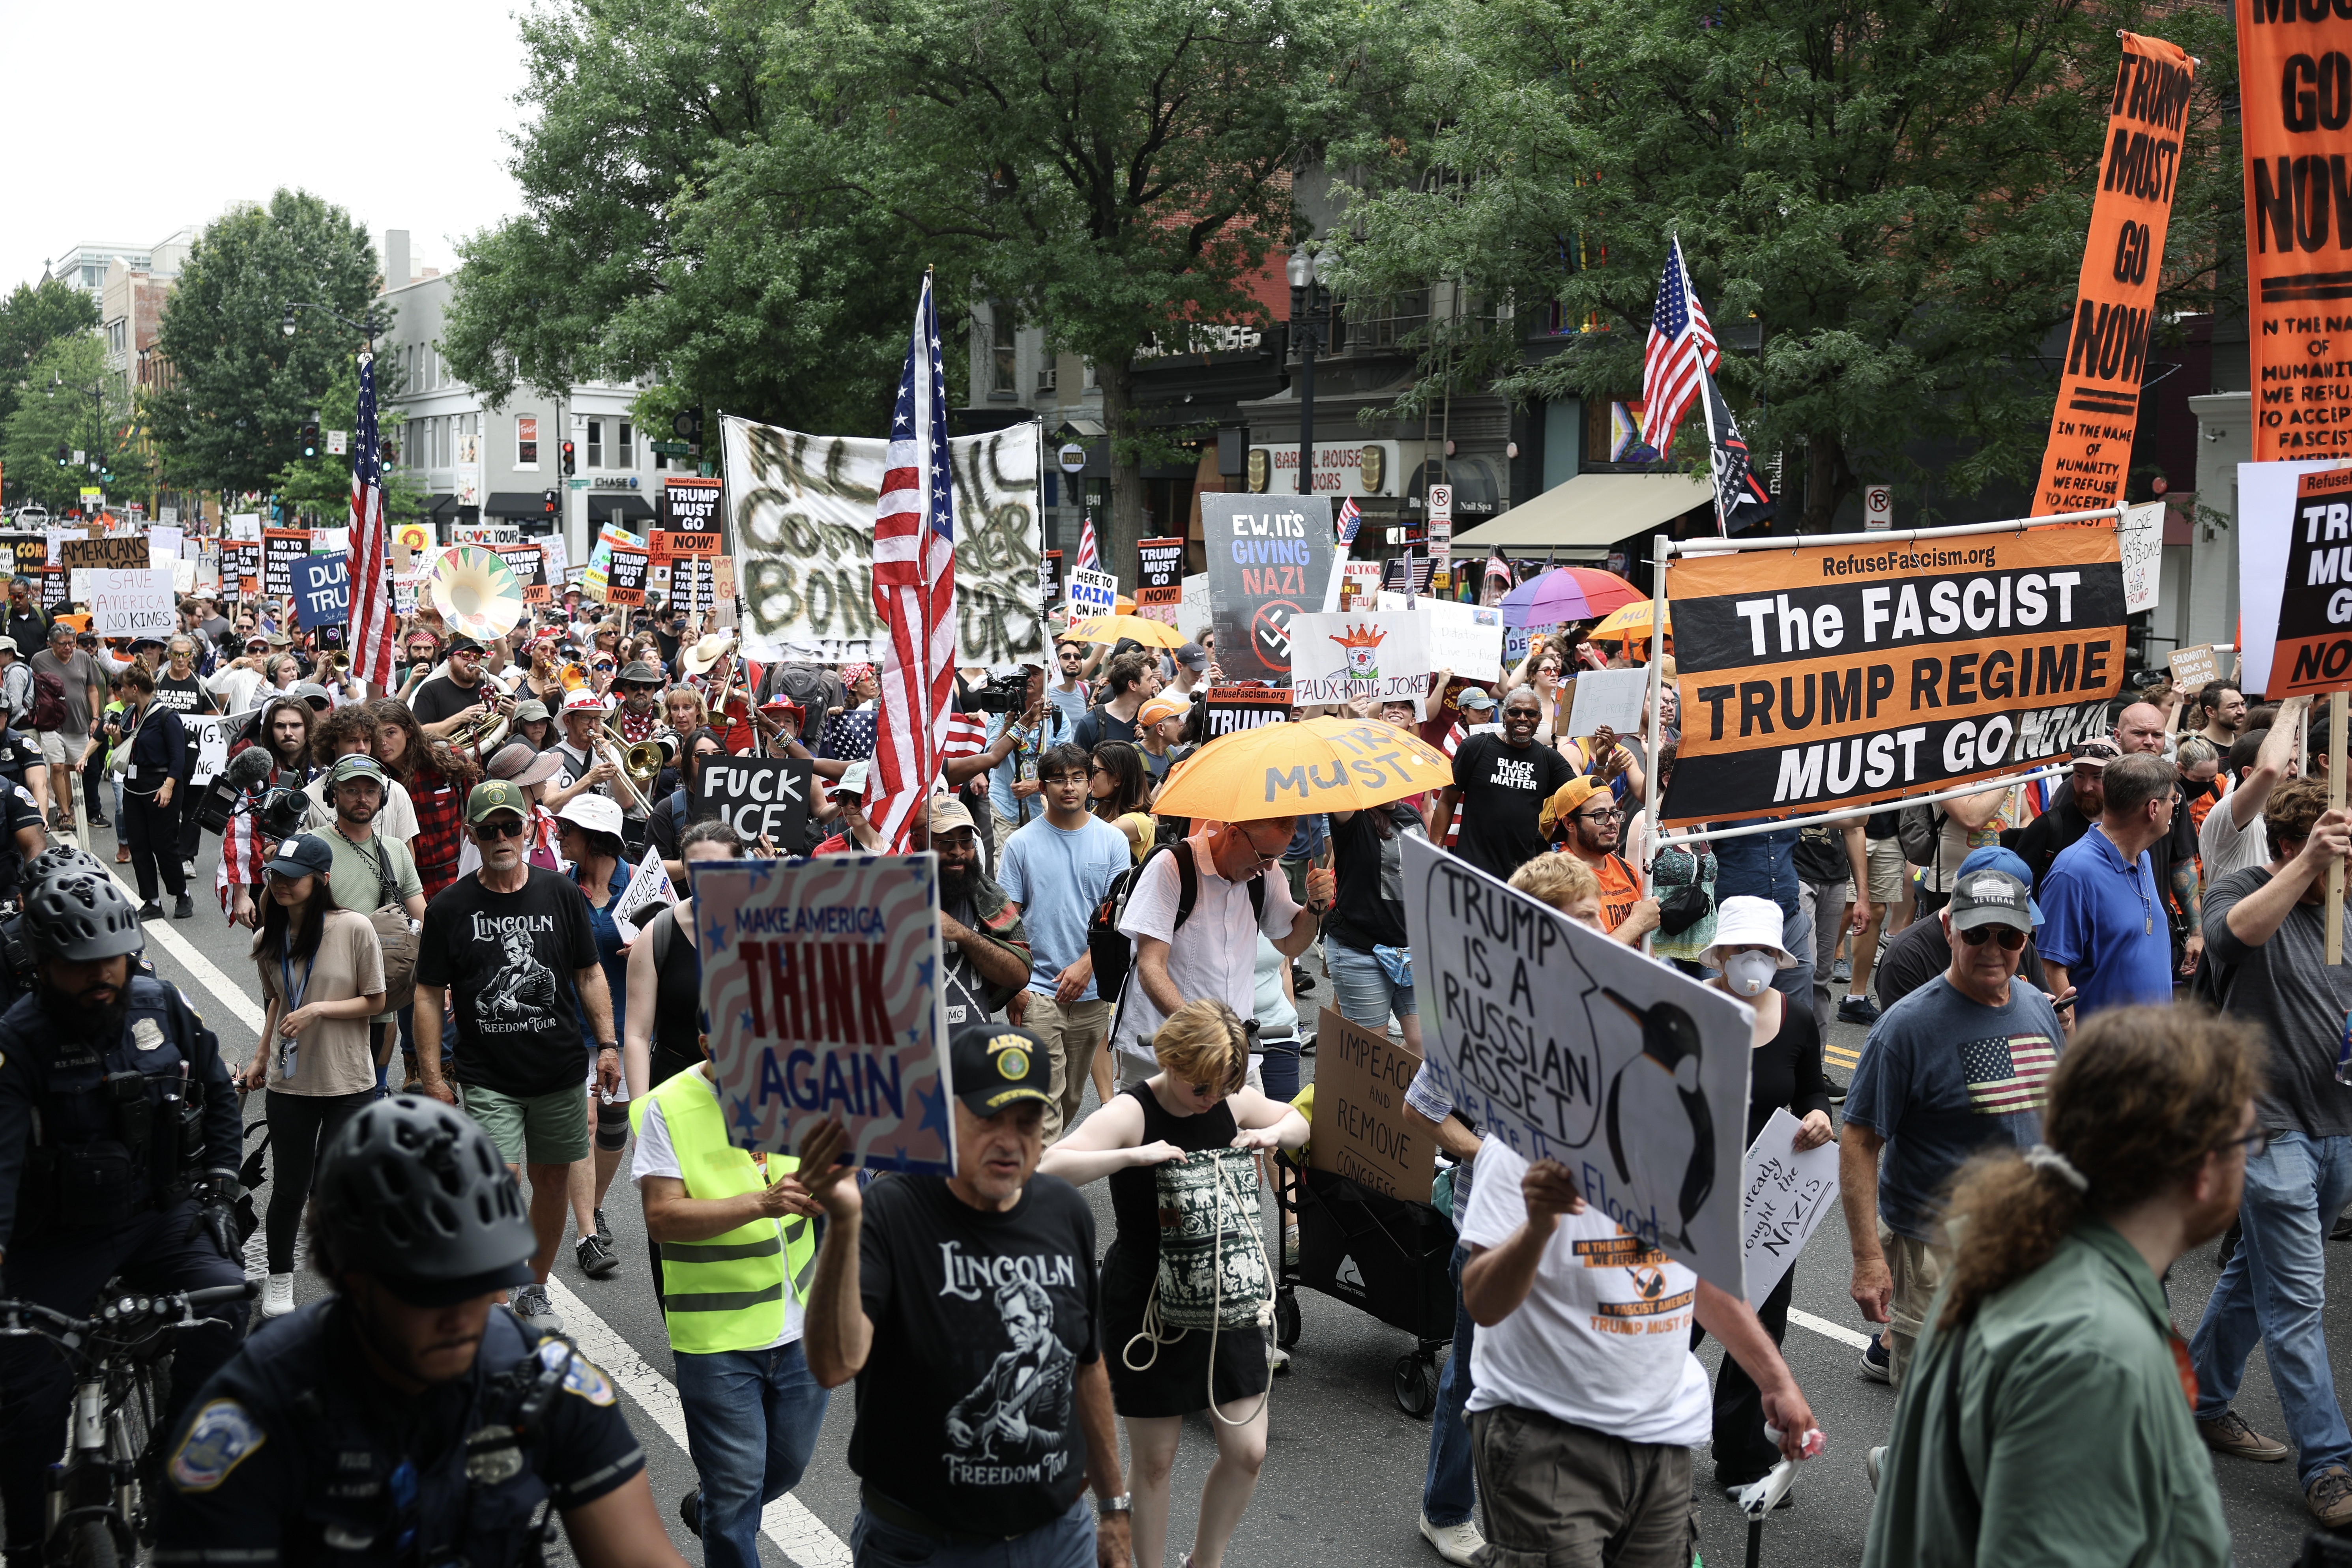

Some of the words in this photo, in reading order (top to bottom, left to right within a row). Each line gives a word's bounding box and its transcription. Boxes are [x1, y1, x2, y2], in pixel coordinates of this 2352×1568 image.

[2112, 52, 2192, 132] TRUMP
[2281, 52, 2352, 133] GO
[2103, 129, 2178, 204] MUST
[2113, 219, 2150, 285] GO
[2285, 316, 2321, 334] THE
[2068, 299, 2152, 384] NOW
[2308, 340, 2330, 356] OF
[2262, 387, 2294, 404] WE
[2260, 411, 2283, 427] TO
[2057, 421, 2075, 435] IN
[2079, 424, 2100, 438] THE
[2102, 427, 2132, 442] NAME
[2086, 443, 2101, 456] OF
[1275, 450, 1318, 469] BARL
[1323, 449, 1361, 468] HOUSE
[2056, 458, 2119, 479] HUMANITY,
[595, 478, 628, 486] CHASE
[1294, 473, 1341, 490] LUORS
[2054, 475, 2071, 489] WE
[2073, 477, 2118, 494] REFUSE
[668, 488, 719, 501] TRUMP
[1086, 495, 1101, 505] 1341
[2045, 492, 2061, 505] TO
[2063, 494, 2108, 509] ACCEPT
[673, 503, 714, 516] MUST
[1460, 501, 1476, 510] Nail
[1477, 502, 1492, 513] Spa
[683, 517, 704, 530] GO
[1232, 514, 1274, 539] EW,
[1276, 509, 1305, 537] IT'S
[2126, 511, 2153, 543] MORE
[494, 530, 518, 543] YOUR
[615, 530, 629, 539] STOP
[673, 536, 714, 549] NOW!
[61, 537, 149, 562] AMERICANS
[273, 540, 287, 550] NO
[290, 541, 302, 550] TO
[1232, 539, 1310, 566] GIVING
[2136, 538, 2161, 564] B-DAYS
[500, 551, 540, 563] TRUMP
[613, 553, 648, 566] TRUMP
[1140, 548, 1181, 561] TRUMP
[1823, 546, 1995, 577] RefuseFascism.org
[165, 561, 181, 572] NO
[224, 563, 238, 571] TRUMP'S
[614, 565, 643, 577] MUST
[698, 563, 711, 571] TO
[1144, 561, 1177, 573] MUST
[2129, 567, 2145, 583] USA
[107, 570, 154, 590] SAVE
[224, 573, 238, 581] FASCIST
[620, 576, 635, 587] GO
[1077, 571, 1099, 586] HERE
[1102, 576, 1112, 588] TO
[1152, 574, 1169, 585] GO
[1242, 566, 1305, 595] NAZI
[223, 582, 239, 591] MILITARY
[612, 589, 640, 601] NOW!
[1072, 584, 1114, 606] RAIN
[1144, 588, 1177, 602] NOW!
[2129, 582, 2143, 593] OVER
[97, 594, 166, 612] AMERICA
[2127, 588, 2149, 606] TRUMP
[1076, 604, 1089, 616] ON
[1736, 594, 1843, 656] The
[1862, 572, 2080, 642] FASCIST
[107, 612, 126, 630] NO
[130, 611, 171, 628] KINGS
[1442, 627, 1480, 640] Dictator
[1441, 644, 1460, 656] Live
[1467, 649, 1476, 657] In
[2172, 649, 2207, 665] SOLIDARITY
[1455, 664, 1473, 675] Lover
[2178, 662, 2200, 675] KNOWS
[2202, 660, 2212, 670] NO
[1295, 678, 1380, 702] FAUX-KING
[1385, 674, 1429, 696] JOKE!
[1585, 679, 1595, 690] I
[1600, 672, 1629, 689] HONK
[2182, 672, 2214, 687] BORDERS
[1212, 688, 1285, 700] RefuseFascism.org
[1697, 664, 1894, 741] TRUMP
[1911, 640, 2111, 710] REGIME
[1589, 695, 1602, 704] for
[1577, 708, 1597, 720] DUE
[1605, 702, 1637, 715] PROCESS
[1209, 710, 1285, 735] TRUMP
[1497, 758, 1534, 772] BLACK
[1774, 728, 1926, 802] MUST
[1943, 715, 2013, 788] GO
[1265, 751, 1413, 802] MUST
[1490, 774, 1537, 790] MATTER
[1499, 767, 1531, 780] LIVES
[482, 782, 508, 795] ARMY
[704, 766, 803, 802] FUCK
[721, 804, 788, 842] ICE
[1974, 896, 2014, 906] VETERAN
[735, 907, 790, 933] MAKE
[795, 907, 885, 934] AMERICA
[1441, 864, 1557, 967] TRUMP
[471, 911, 554, 942] LINCOLN
[1462, 934, 1492, 989] IS
[1509, 956, 1535, 1018] A
[738, 941, 896, 1046] THINK
[475, 1018, 528, 1035] FREEDOM
[528, 1016, 556, 1033] TOUR
[986, 1033, 1034, 1055] ARMY
[1442, 972, 1592, 1107] RUSSIAN
[71, 1056, 96, 1066] PALMA
[1340, 1029, 1419, 1091] IMPEACH
[759, 1046, 904, 1119] AGAIN
[1458, 1032, 1572, 1140] ASSET
[1369, 1085, 1390, 1109] AND
[1338, 1098, 1411, 1169] REMOVE
[1779, 1166, 1799, 1192] the
[1581, 1161, 1658, 1246] Flood
[1577, 1242, 1590, 1254] IN
[1592, 1241, 1613, 1253] THE
[1592, 1254, 1608, 1265] WE
[1612, 1254, 1647, 1265] REFUSE
[1651, 1252, 1662, 1262] TO
[937, 1240, 1076, 1301] LINCOLN
[1602, 1305, 1611, 1314] A
[1614, 1304, 1654, 1316] FASCIST
[1590, 1315, 1643, 1335] TRUMP
[1647, 1316, 1680, 1334] MUST
[942, 1452, 1040, 1485] FREEDOM
